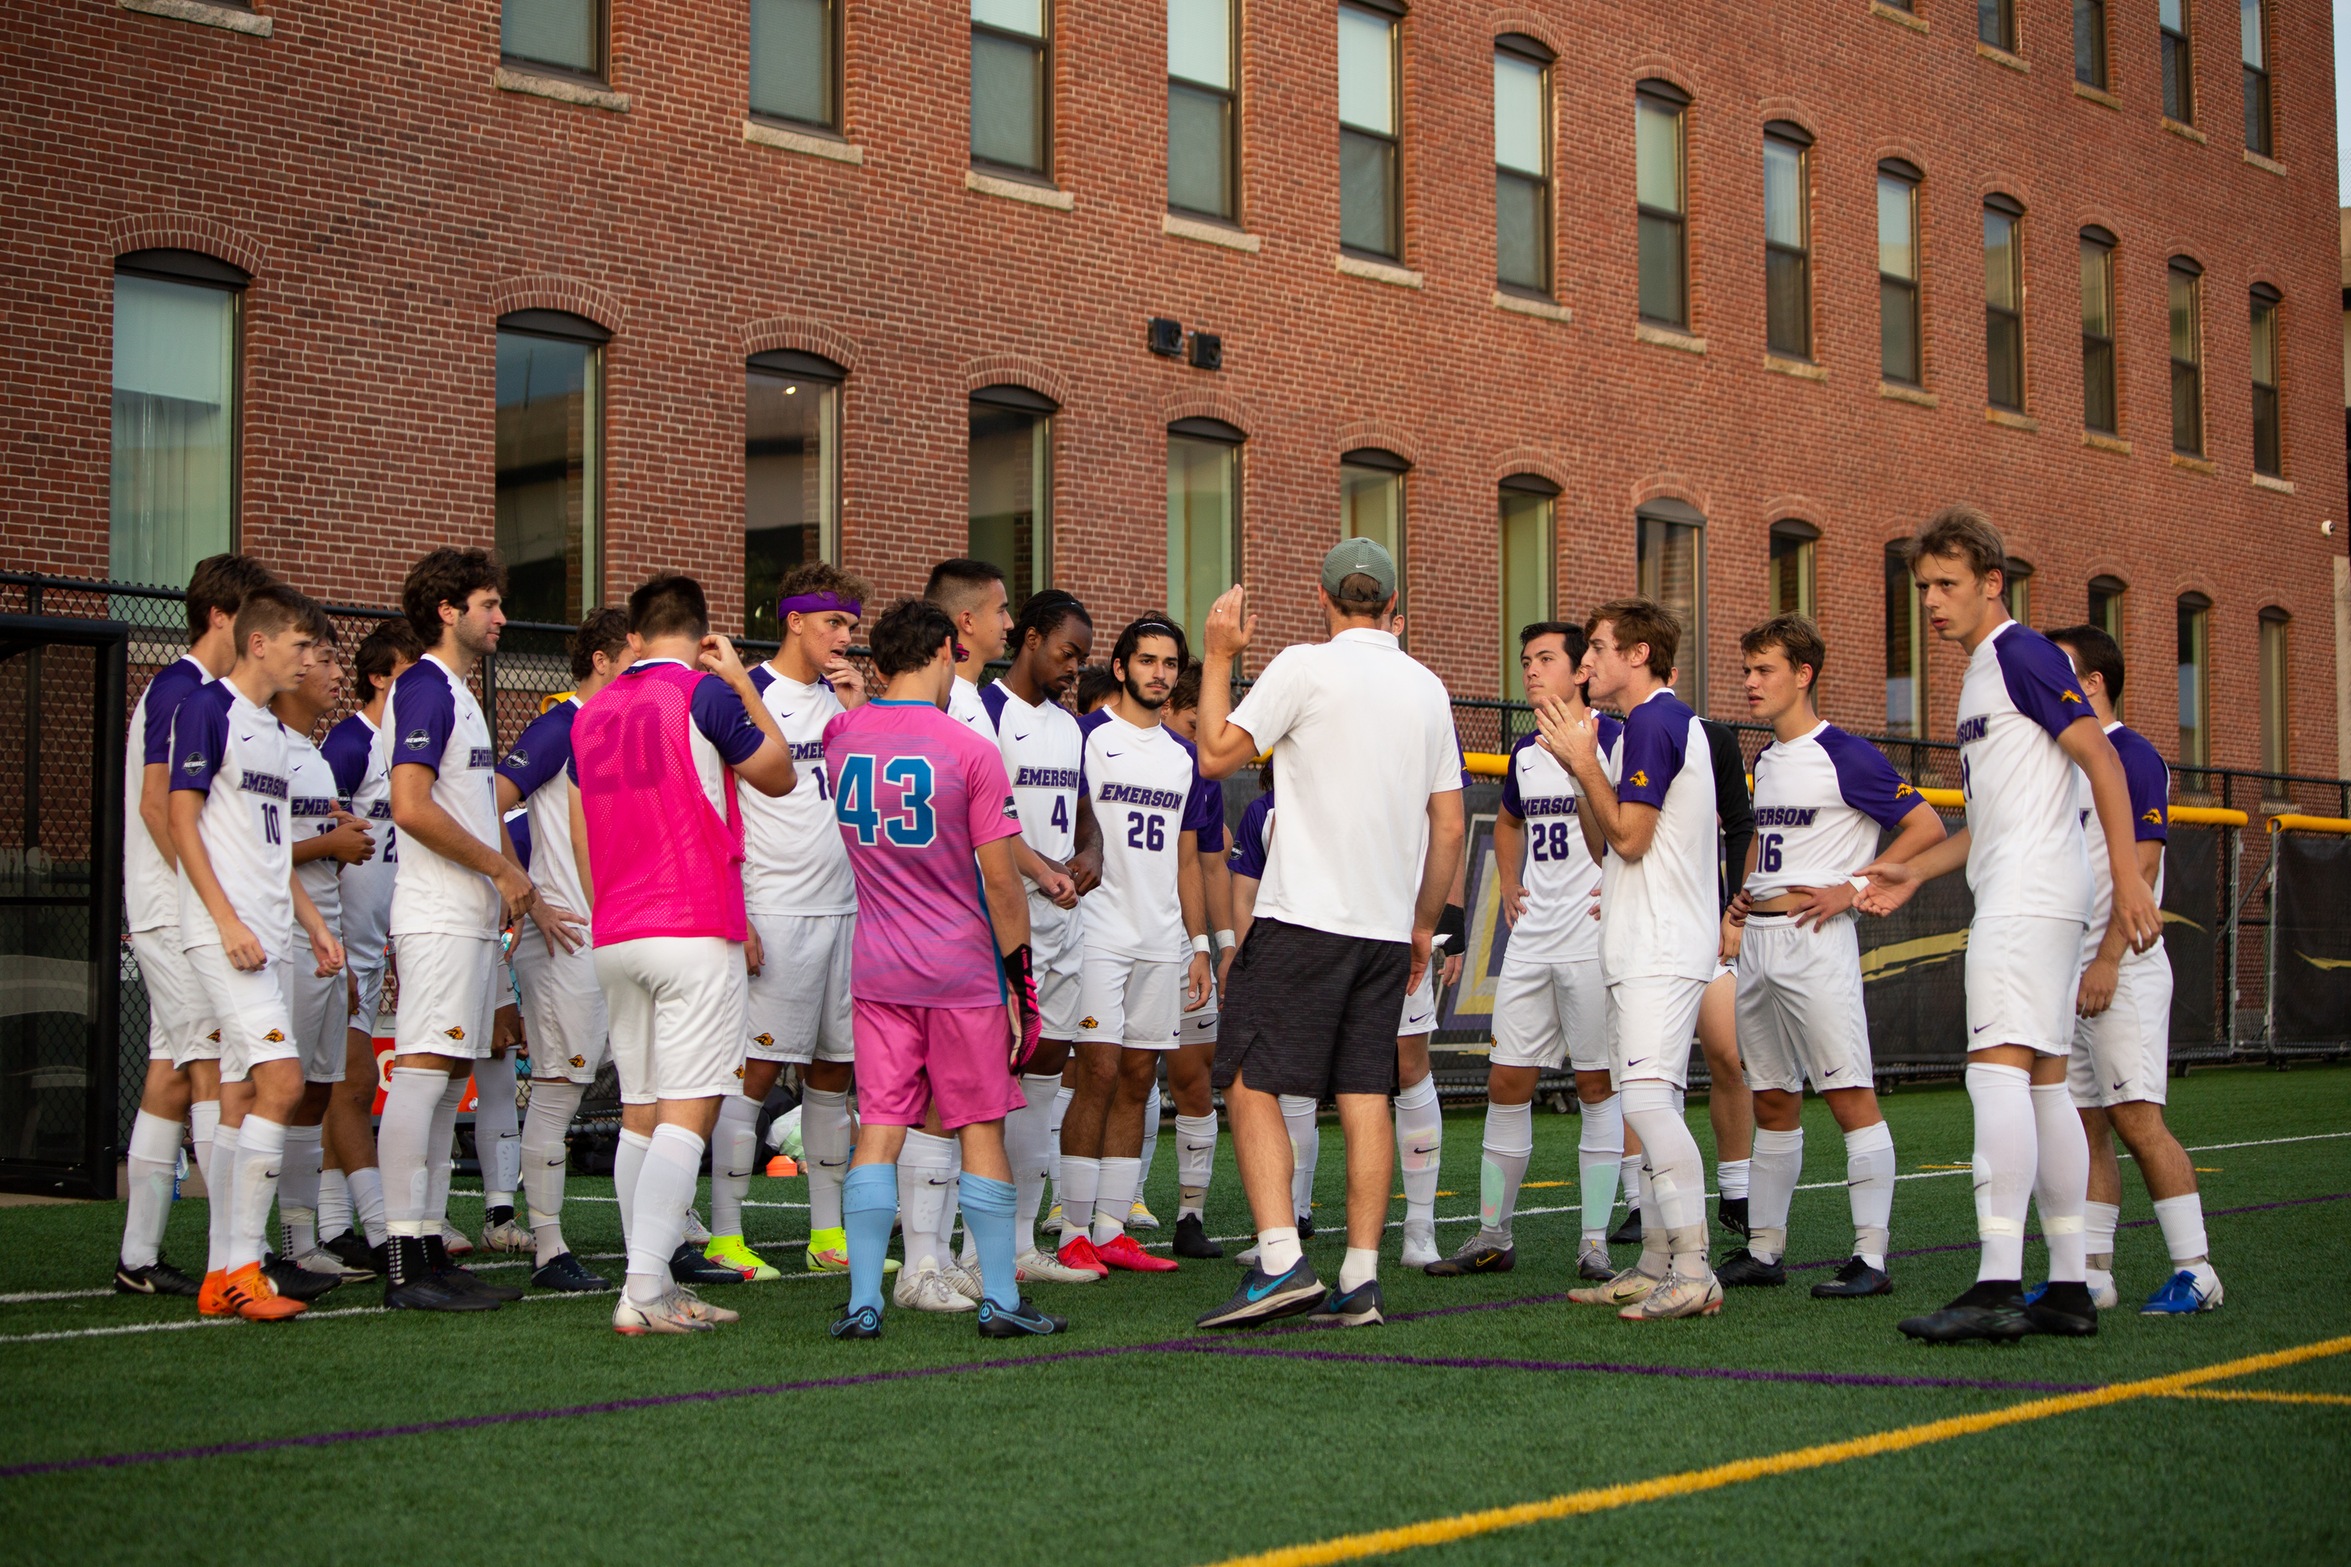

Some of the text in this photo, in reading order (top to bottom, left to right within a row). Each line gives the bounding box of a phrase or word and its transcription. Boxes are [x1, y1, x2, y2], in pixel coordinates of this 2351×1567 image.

[582, 701, 667, 795] 20
[240, 770, 290, 800] EMERSON
[1015, 766, 1079, 789] EMERSON
[1099, 783, 1184, 811] EMERSON
[291, 798, 332, 816] EMER
[835, 752, 936, 849] 43
[1050, 795, 1069, 834] 4
[1521, 796, 1578, 816] MERSO
[1754, 807, 1817, 827] MERSON
[261, 802, 281, 846] 10
[1127, 811, 1166, 852] 26
[1531, 822, 1569, 862] 28
[1758, 833, 1784, 874] 16
